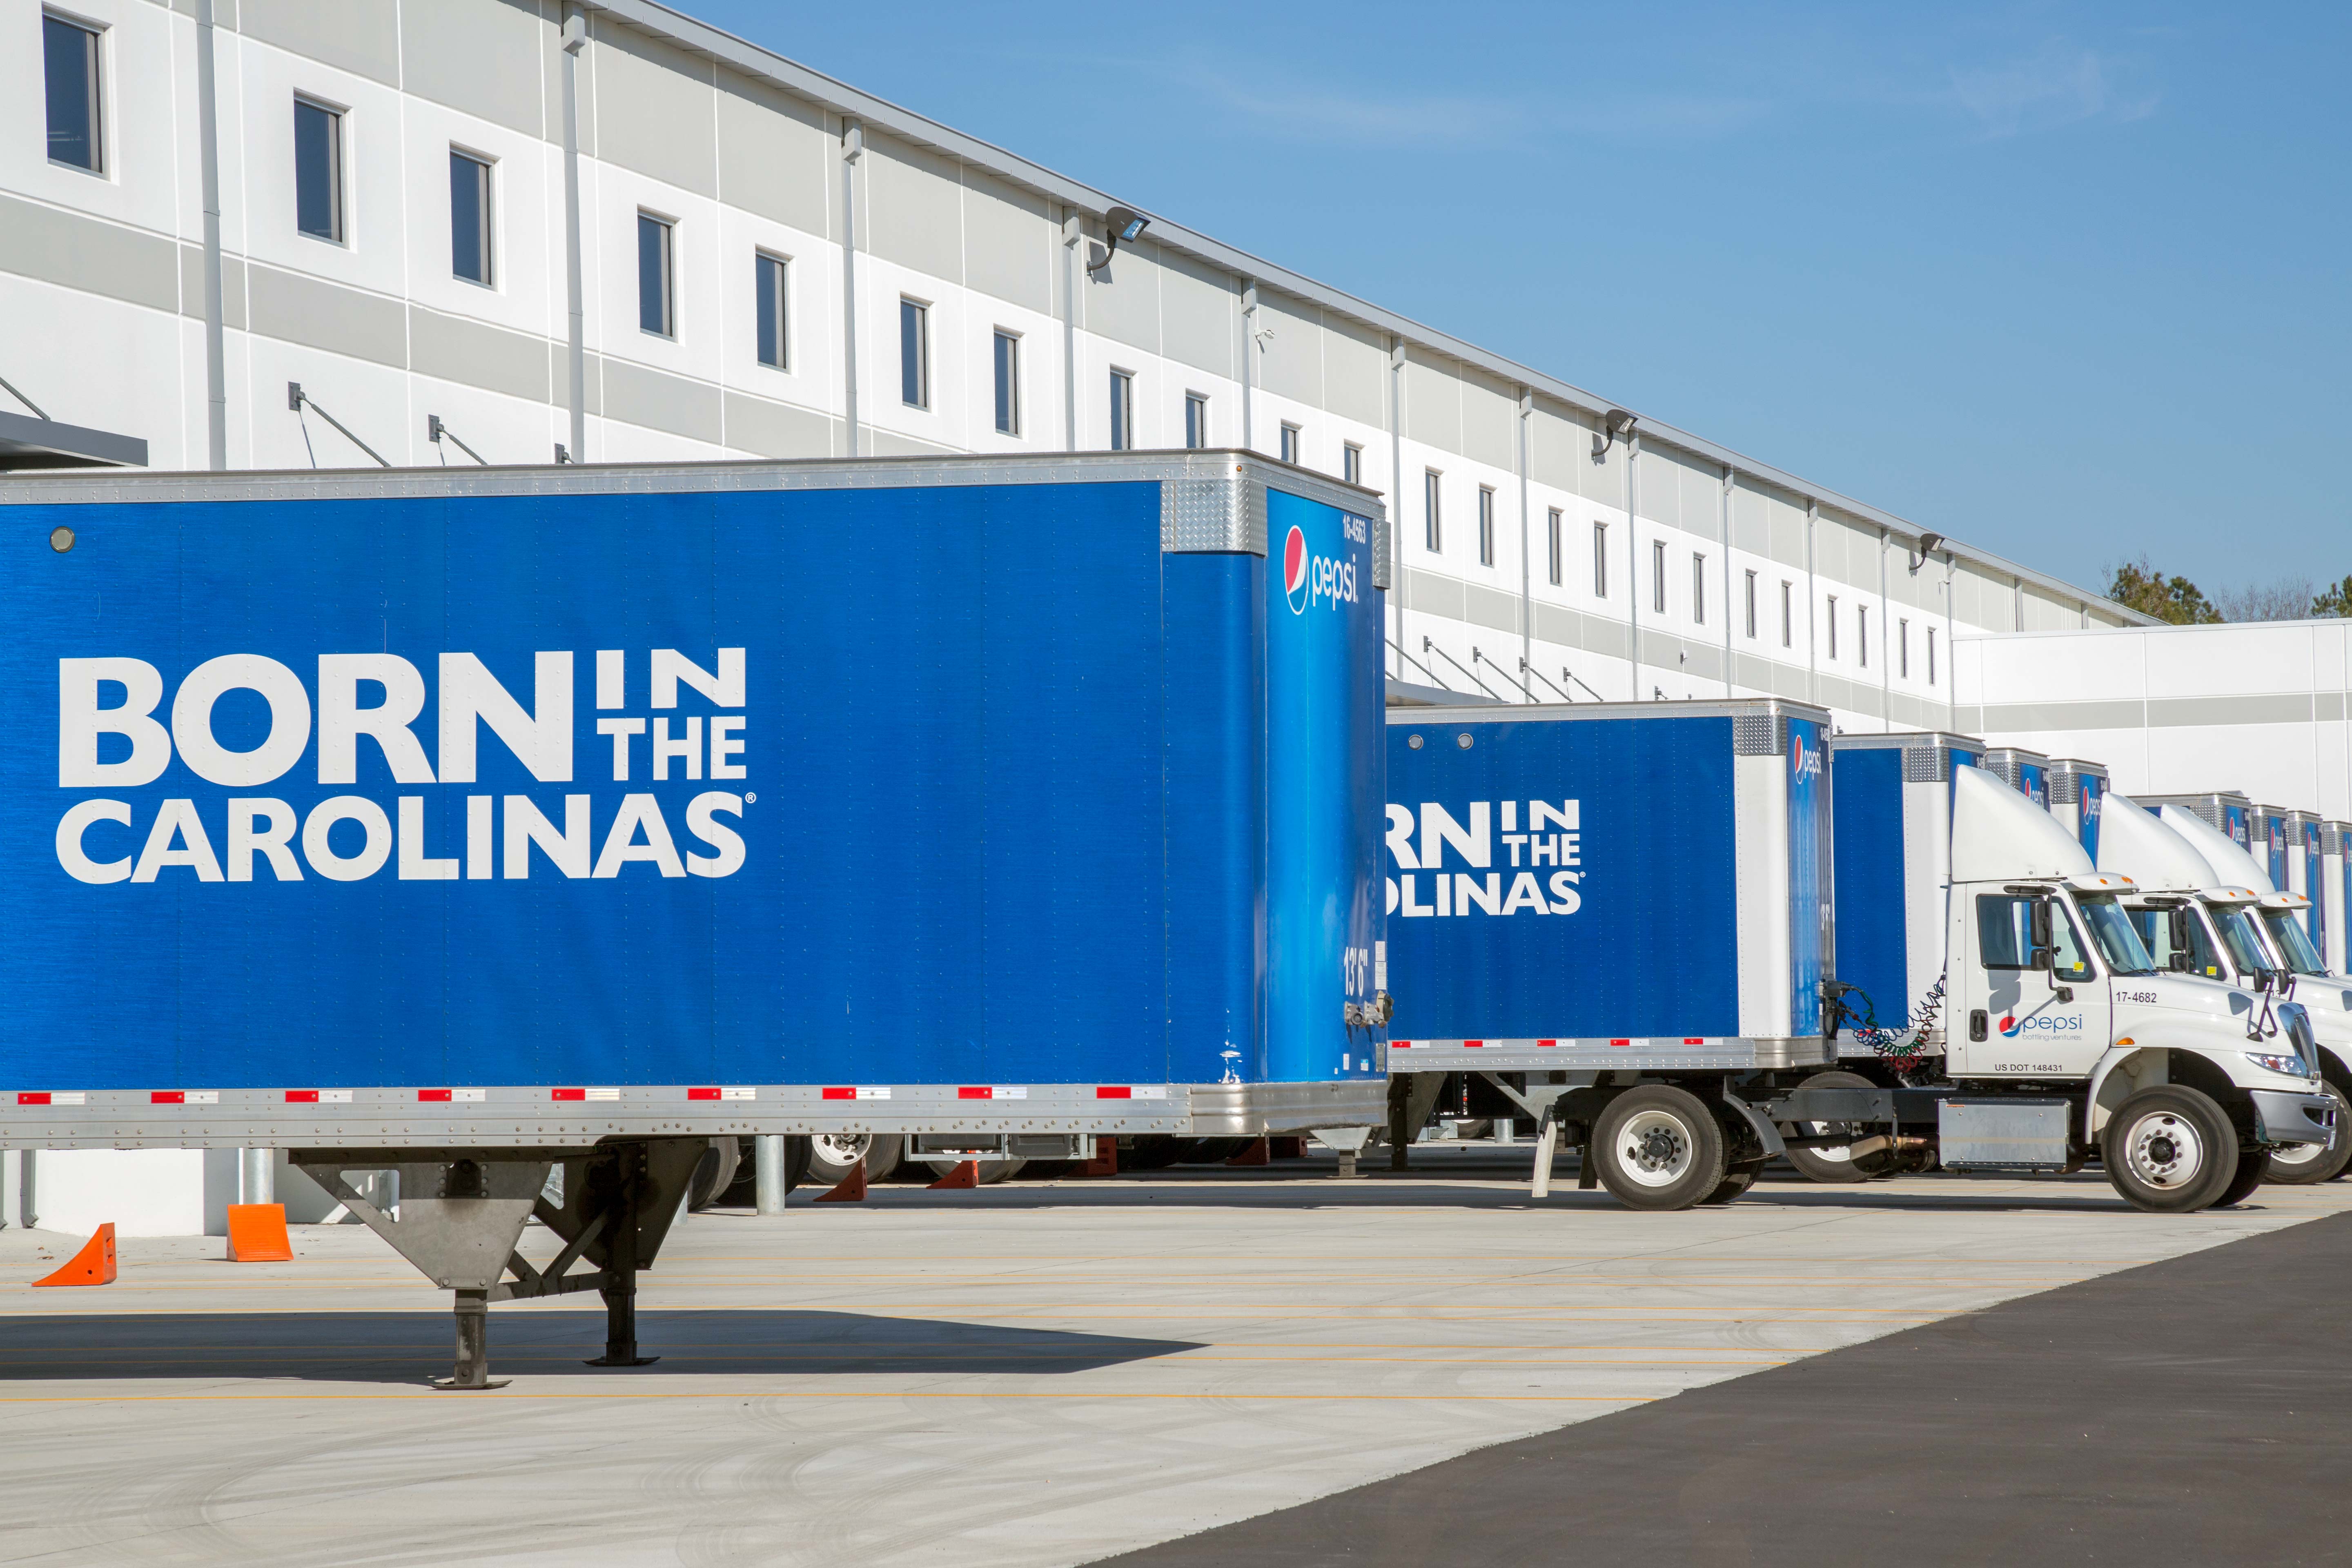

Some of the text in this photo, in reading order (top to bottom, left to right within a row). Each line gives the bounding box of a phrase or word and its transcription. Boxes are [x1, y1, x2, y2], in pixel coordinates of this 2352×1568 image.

[1343, 514, 1365, 544] 16-4563
[1312, 553, 1356, 611] pepsi
[597, 648, 746, 709] IN
[59, 651, 573, 786] BORN
[597, 716, 746, 780] THE
[1804, 746, 1822, 780] pepsi
[1501, 800, 1579, 831] IN
[2090, 794, 2101, 821] peps
[1502, 833, 1580, 866] THE
[2116, 992, 2156, 1002] 17-4682
[2023, 1014, 2082, 1033] pepsi
